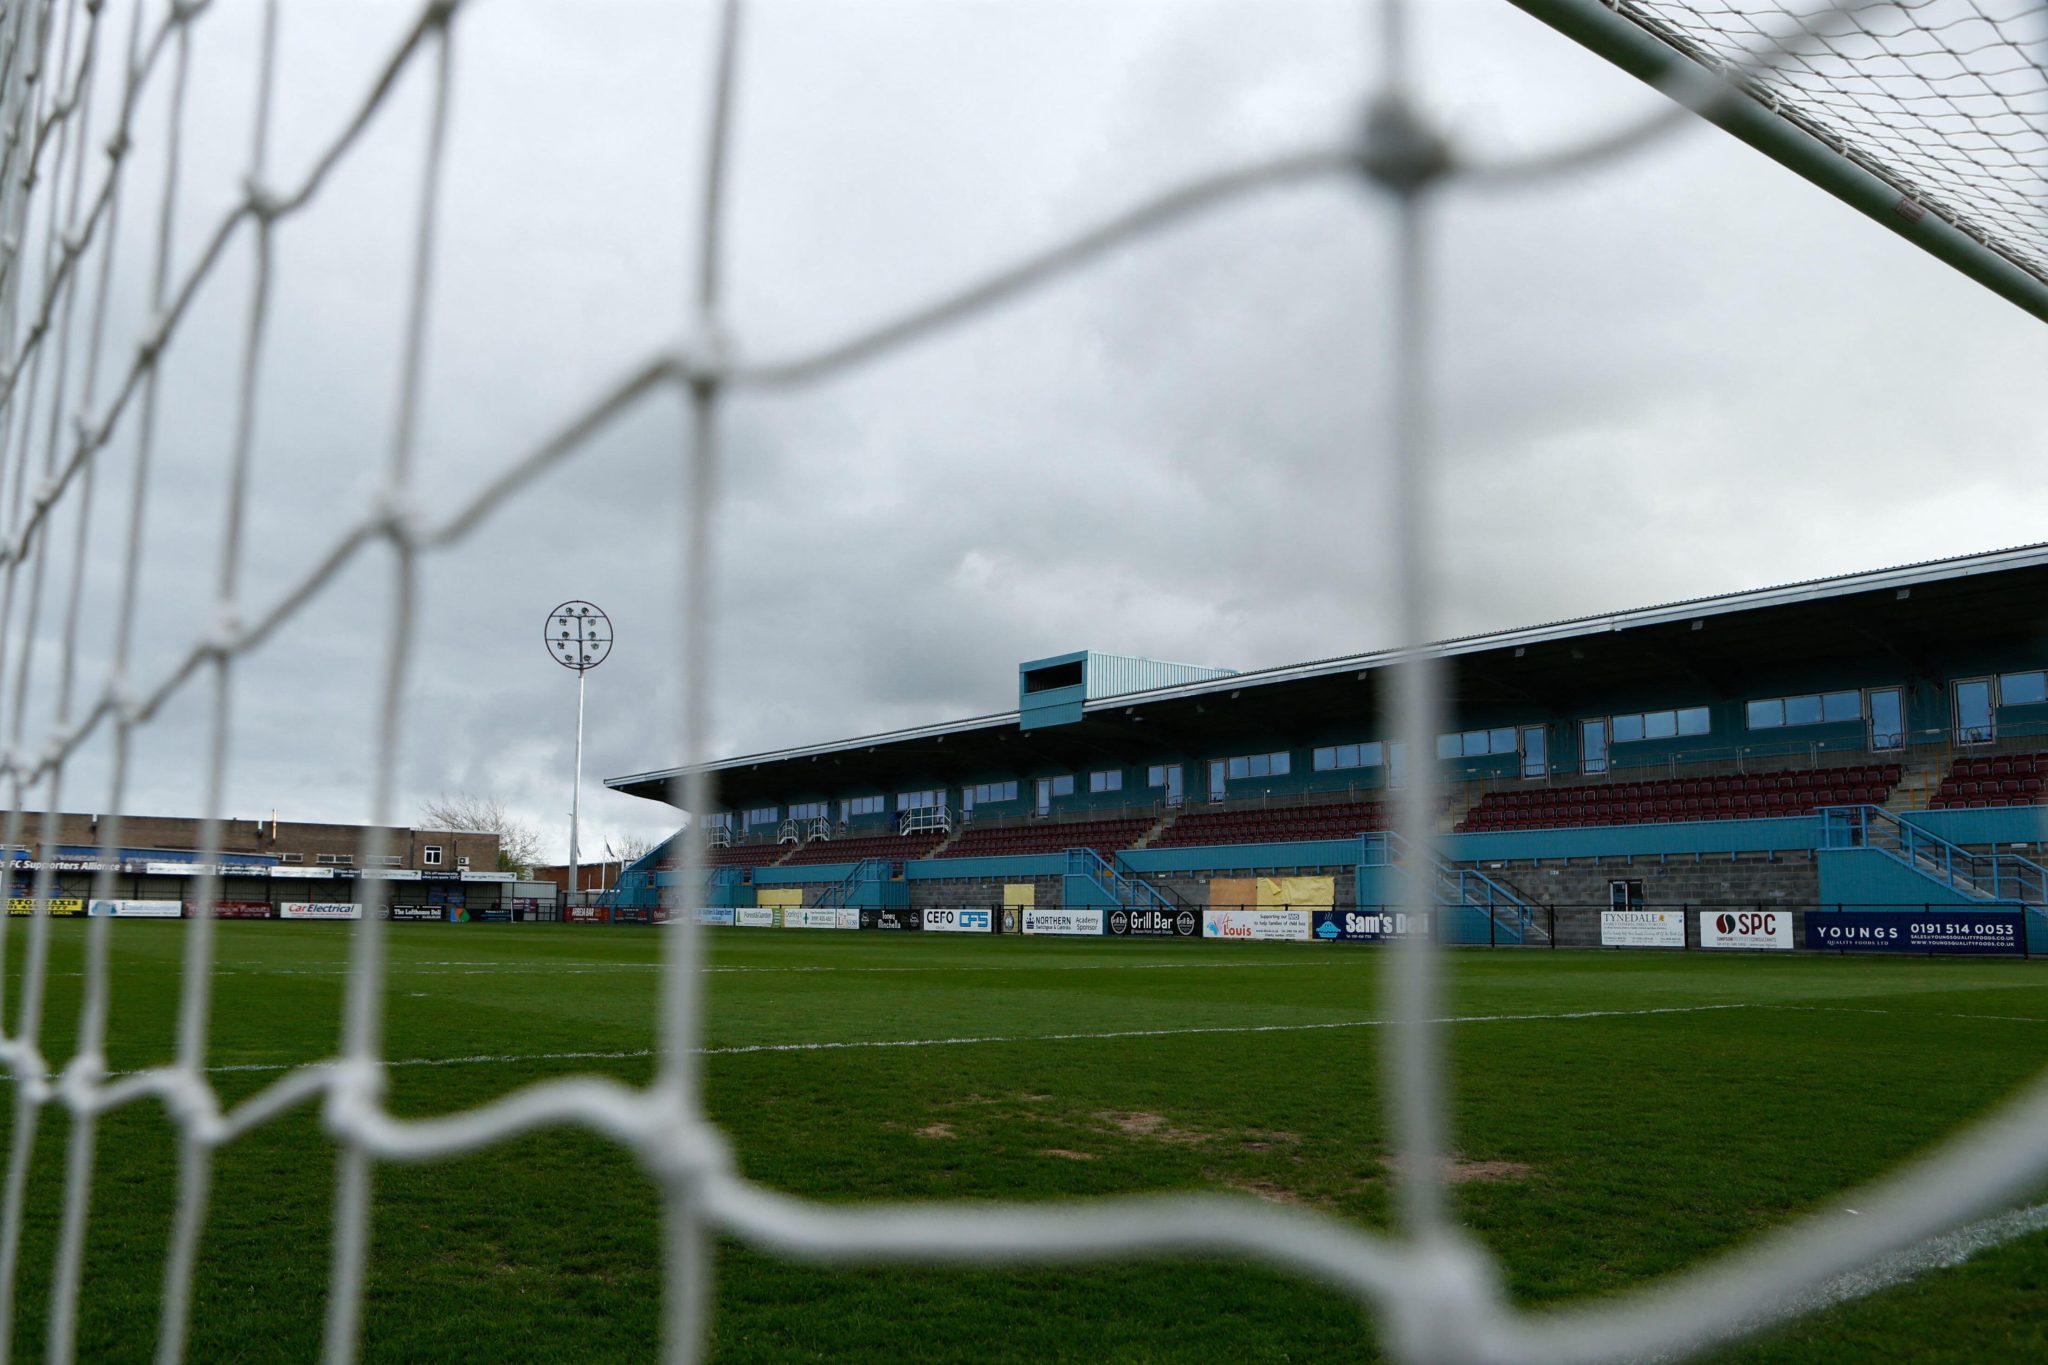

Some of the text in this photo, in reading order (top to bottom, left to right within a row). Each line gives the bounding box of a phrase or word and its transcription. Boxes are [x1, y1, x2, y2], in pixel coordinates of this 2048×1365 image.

[289, 904, 354, 914] Car Electrical
[926, 911, 954, 924] CEFO
[1036, 916, 1072, 925] NORTHERN
[1076, 917, 1099, 925] Academy
[1130, 911, 1173, 929] Grill Bar
[1345, 912, 1393, 934] Sam's
[1604, 913, 1658, 923] TYNEDALE
[1223, 924, 1252, 936] Louis
[1738, 913, 1776, 935] SPC
[1910, 923, 2014, 935] 0191 514 0053
[1817, 926, 1898, 938] YOUNGS
